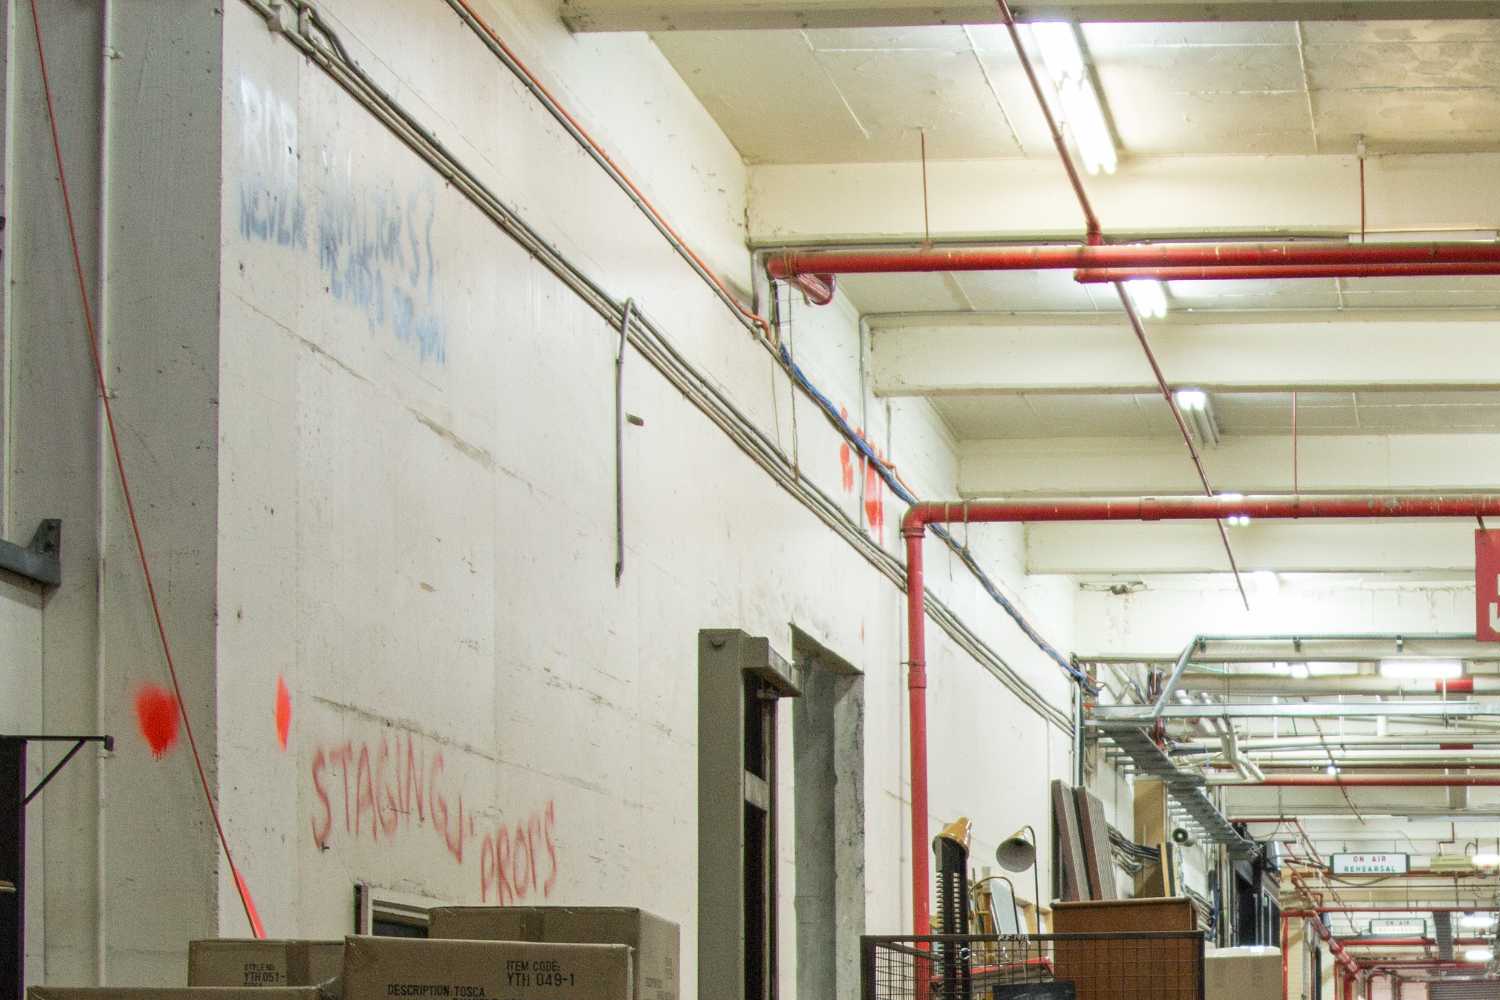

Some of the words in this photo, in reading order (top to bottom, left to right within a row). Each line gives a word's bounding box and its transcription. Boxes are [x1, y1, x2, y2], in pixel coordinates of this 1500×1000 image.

[312, 735, 464, 864] STAGING
[507, 961, 529, 971] ITEM
[508, 973, 530, 986] YTH
[536, 973, 575, 986] 049-1
